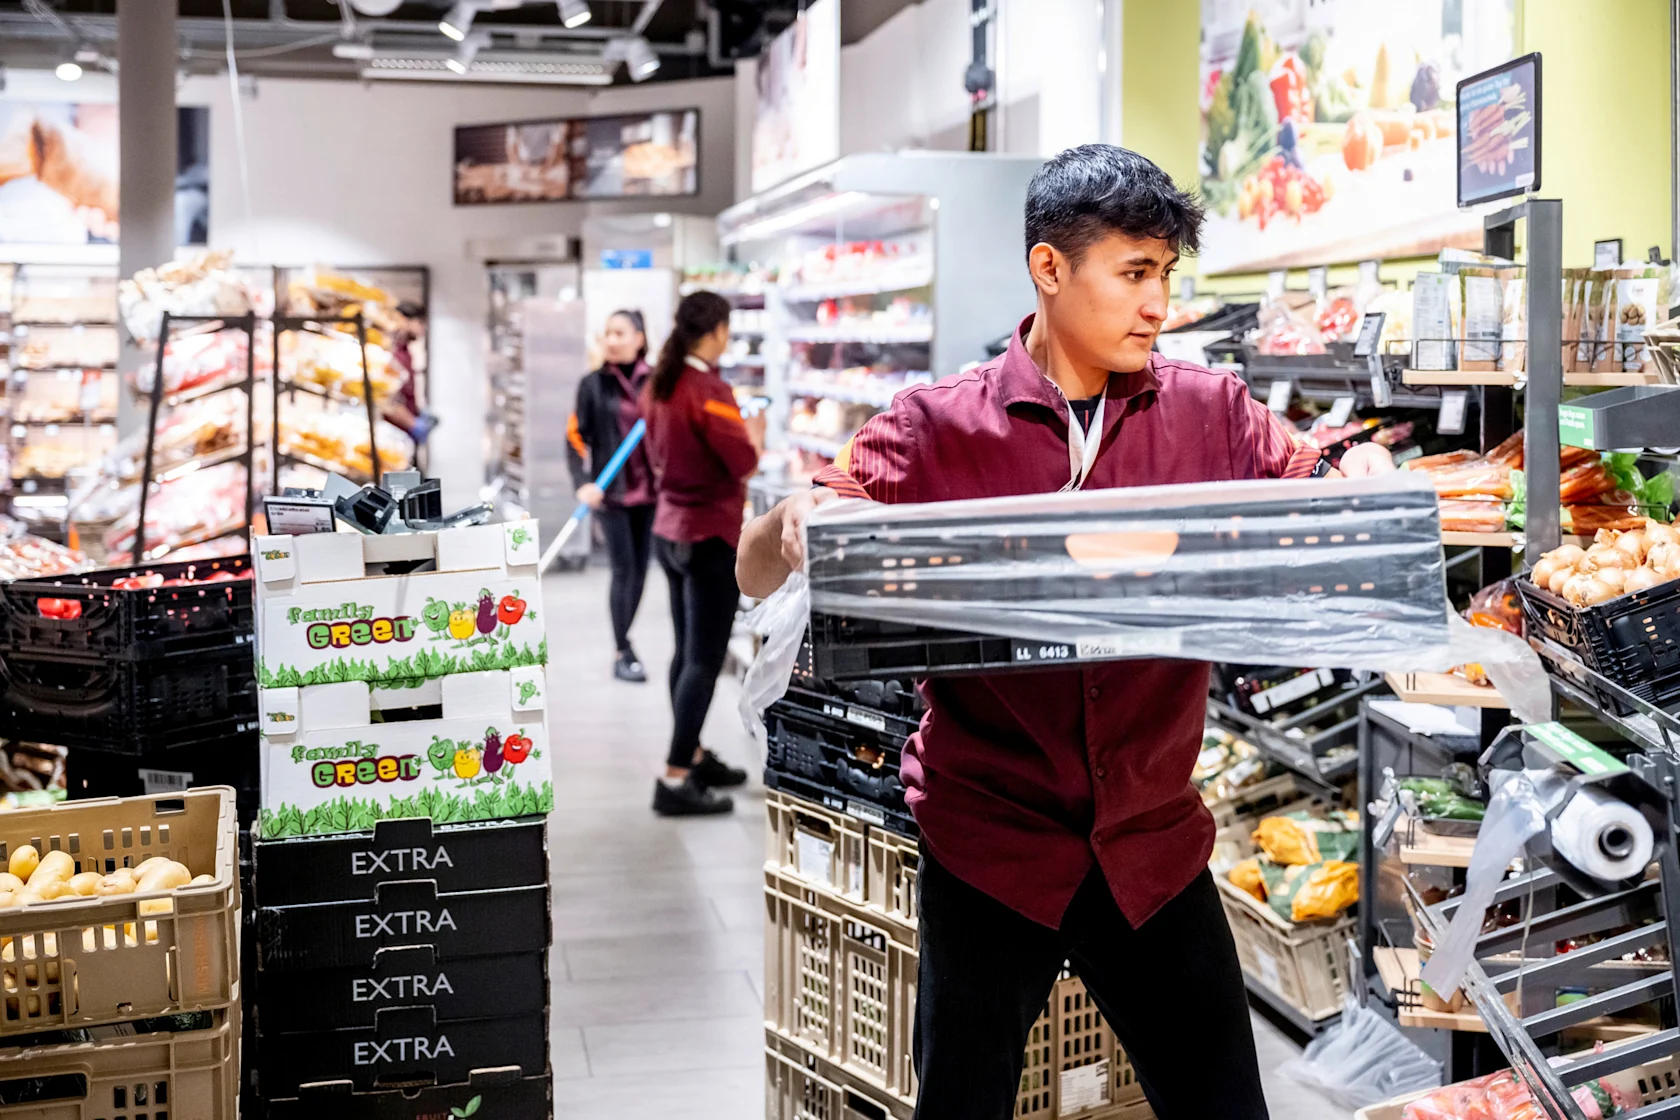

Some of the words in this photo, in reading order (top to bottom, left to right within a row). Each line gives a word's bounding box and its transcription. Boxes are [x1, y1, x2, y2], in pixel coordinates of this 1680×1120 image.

[287, 602, 374, 626] family
[1016, 647, 1031, 660] LL
[1039, 645, 1069, 659] 6413
[291, 740, 380, 764] family
[352, 845, 454, 875] EXTRA
[355, 908, 457, 938] EXTRA
[353, 972, 454, 1001] EXTRA
[354, 1035, 455, 1065] EXTRA
